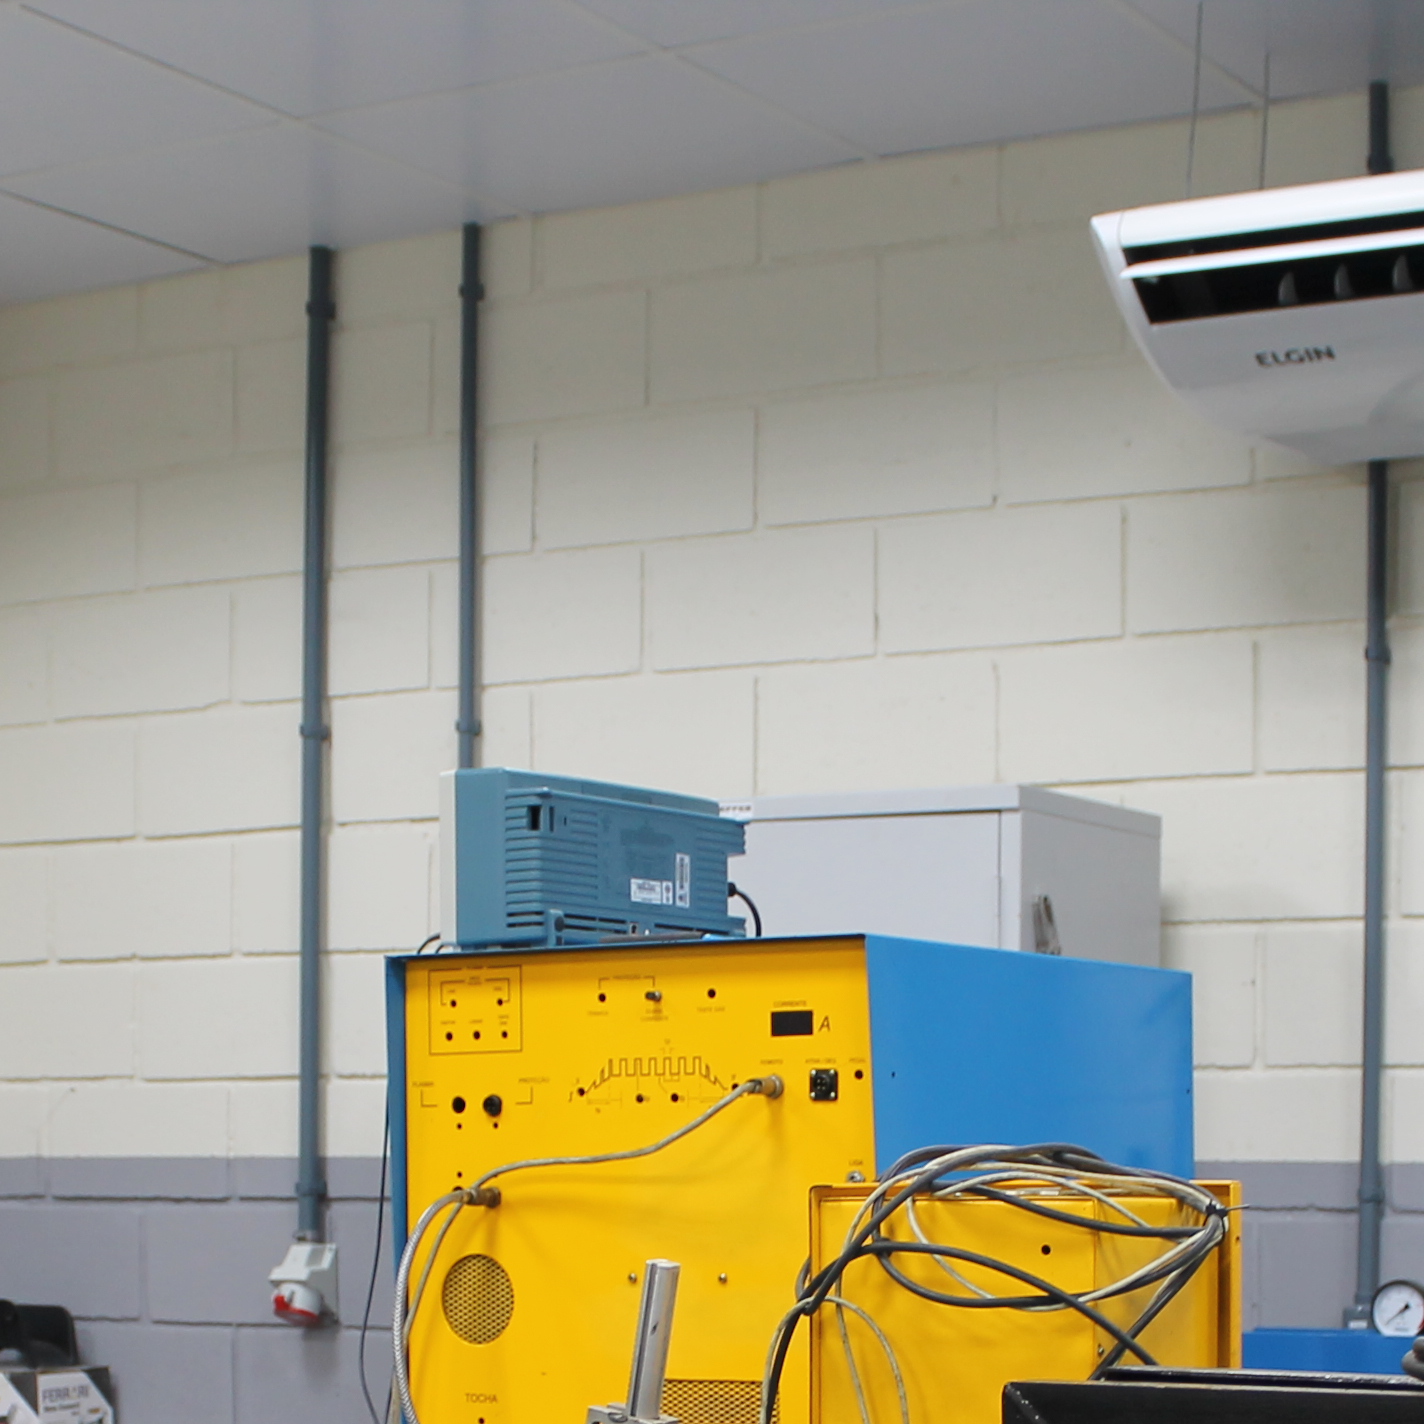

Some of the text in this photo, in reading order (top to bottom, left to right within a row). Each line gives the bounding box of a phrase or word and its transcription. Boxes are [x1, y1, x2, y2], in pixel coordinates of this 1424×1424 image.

[1255, 345, 1336, 368] ELGIN
[818, 1015, 831, 1032] A
[465, 1393, 498, 1404] TOCHA
